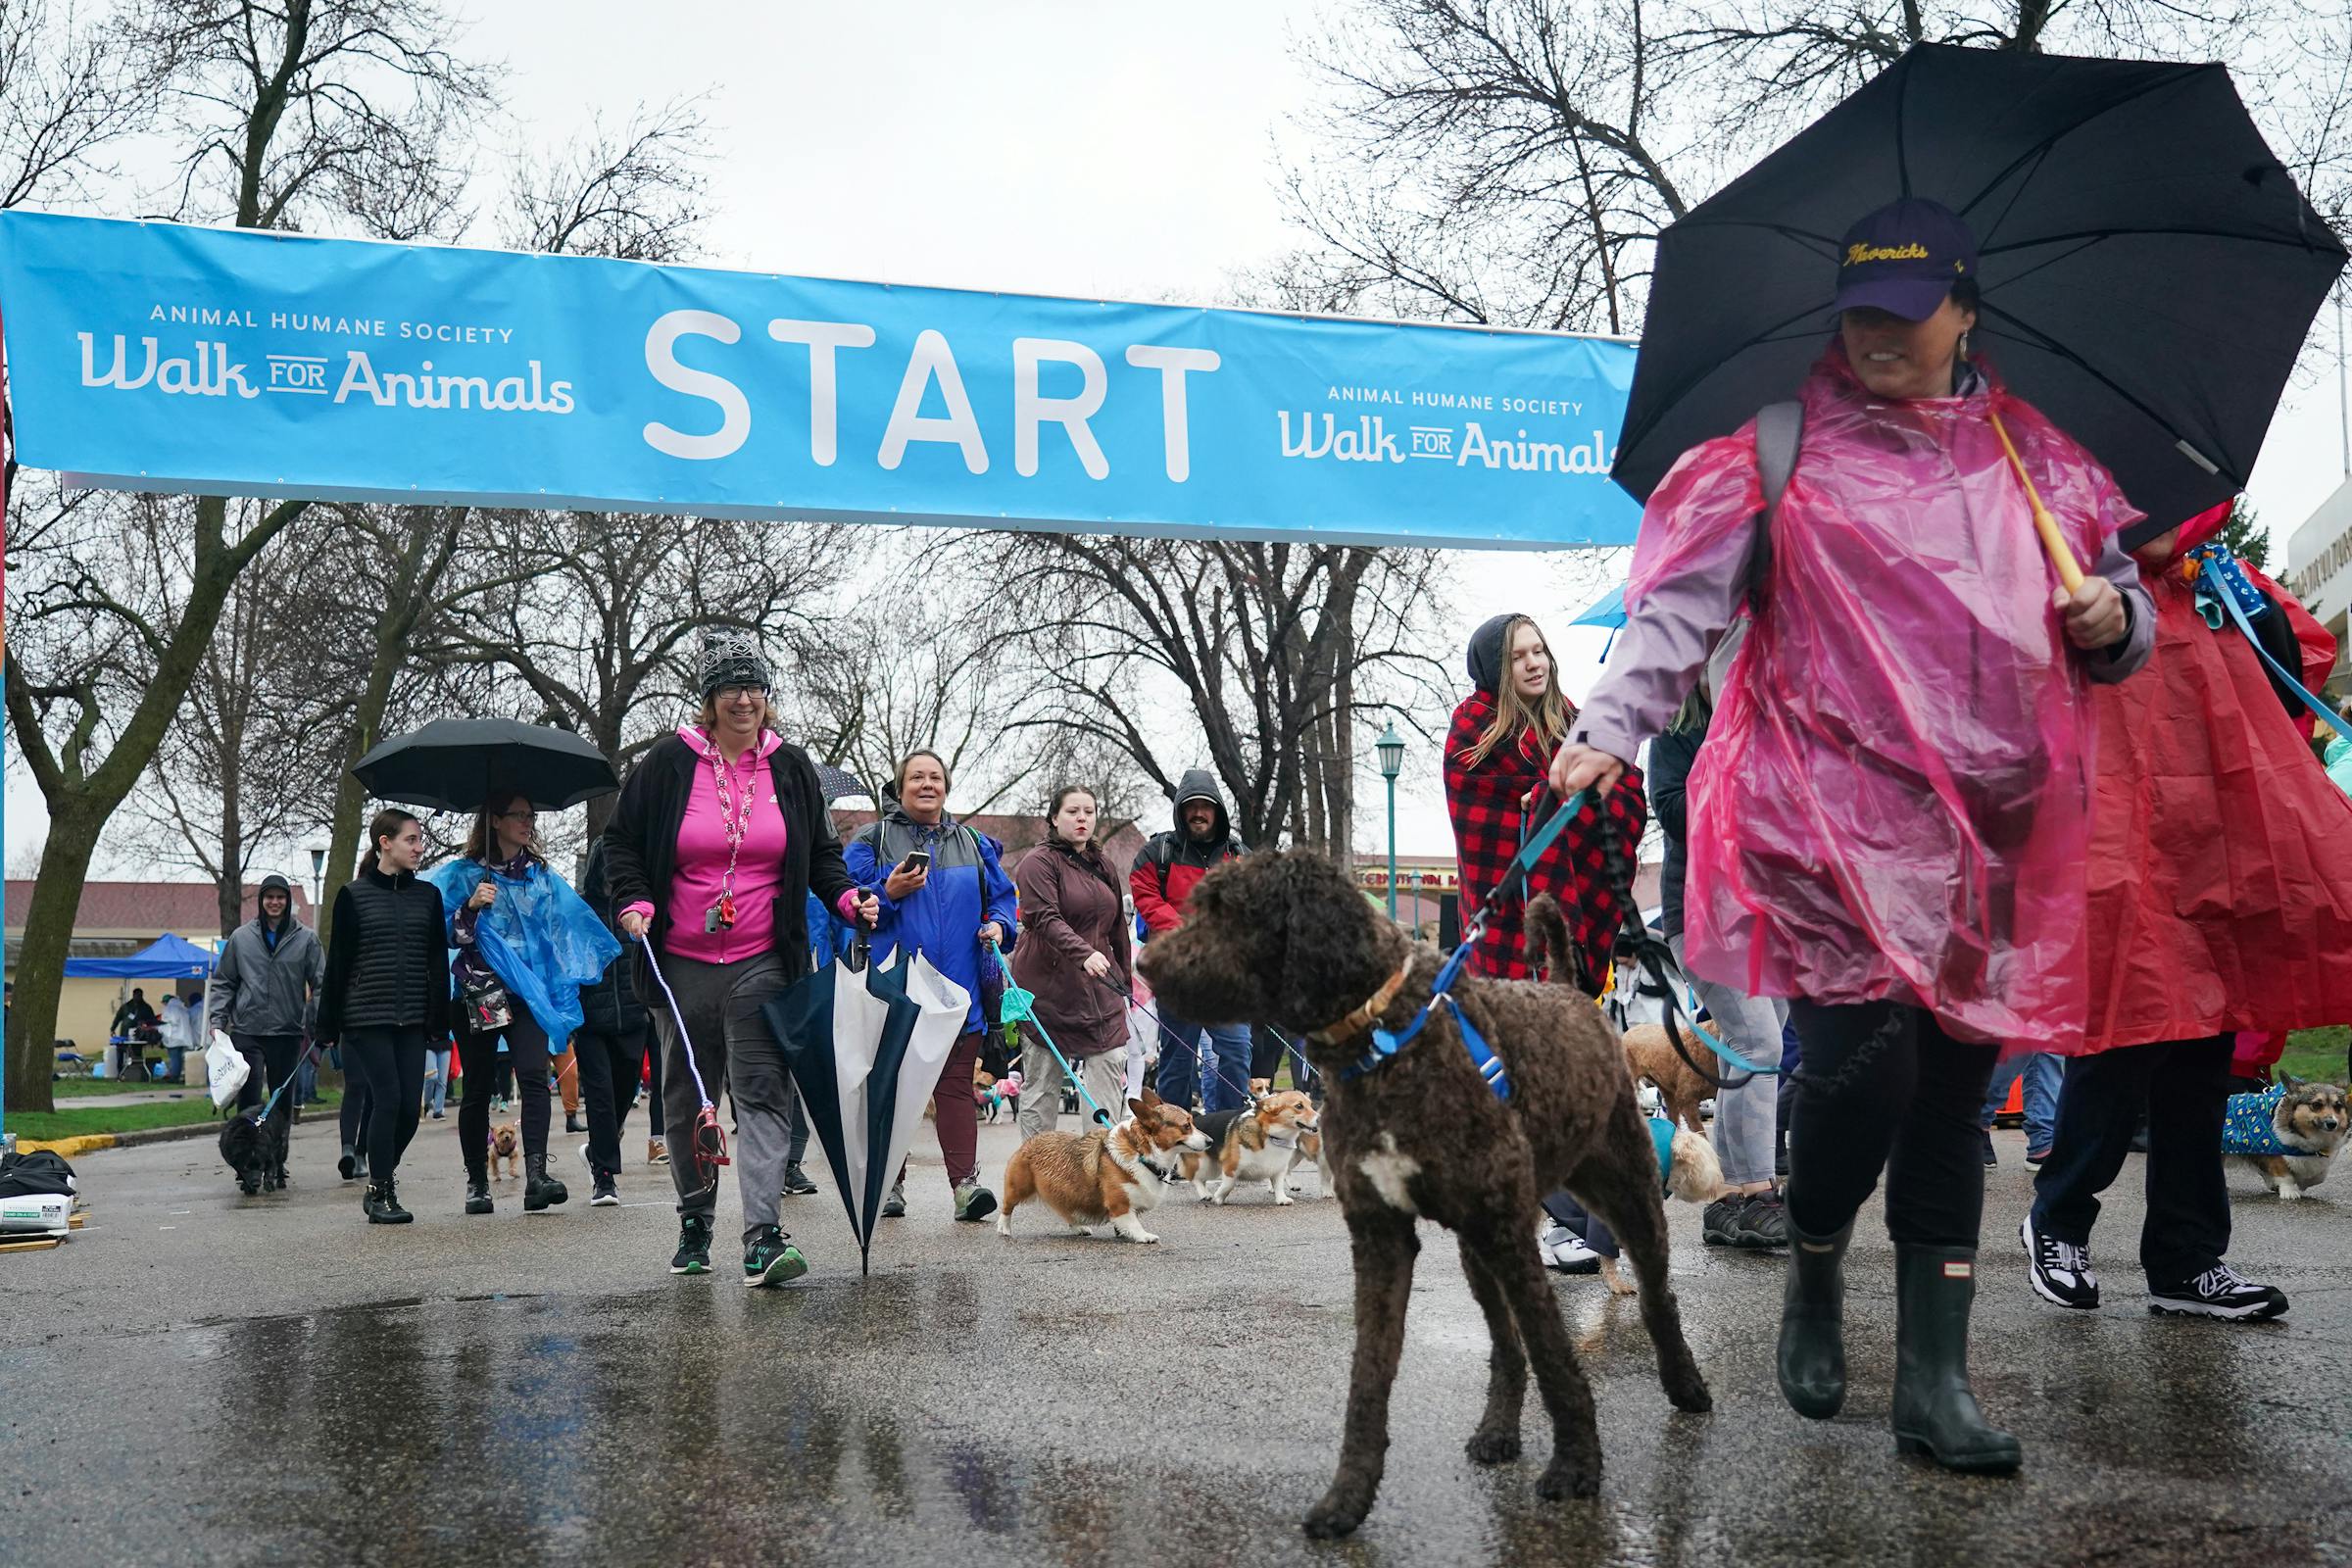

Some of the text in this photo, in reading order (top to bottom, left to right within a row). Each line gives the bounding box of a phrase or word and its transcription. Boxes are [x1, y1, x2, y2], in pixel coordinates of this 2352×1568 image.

[150, 304, 514, 345] ANIMAL HUMANE SOCIETY
[77, 331, 575, 415] Walk FOR Animals
[643, 309, 1221, 483] START
[1328, 385, 1583, 416] ANIMAL HUMANE SOCIETY
[1277, 410, 1406, 464] Walk
[1411, 432, 1451, 455] FOR
